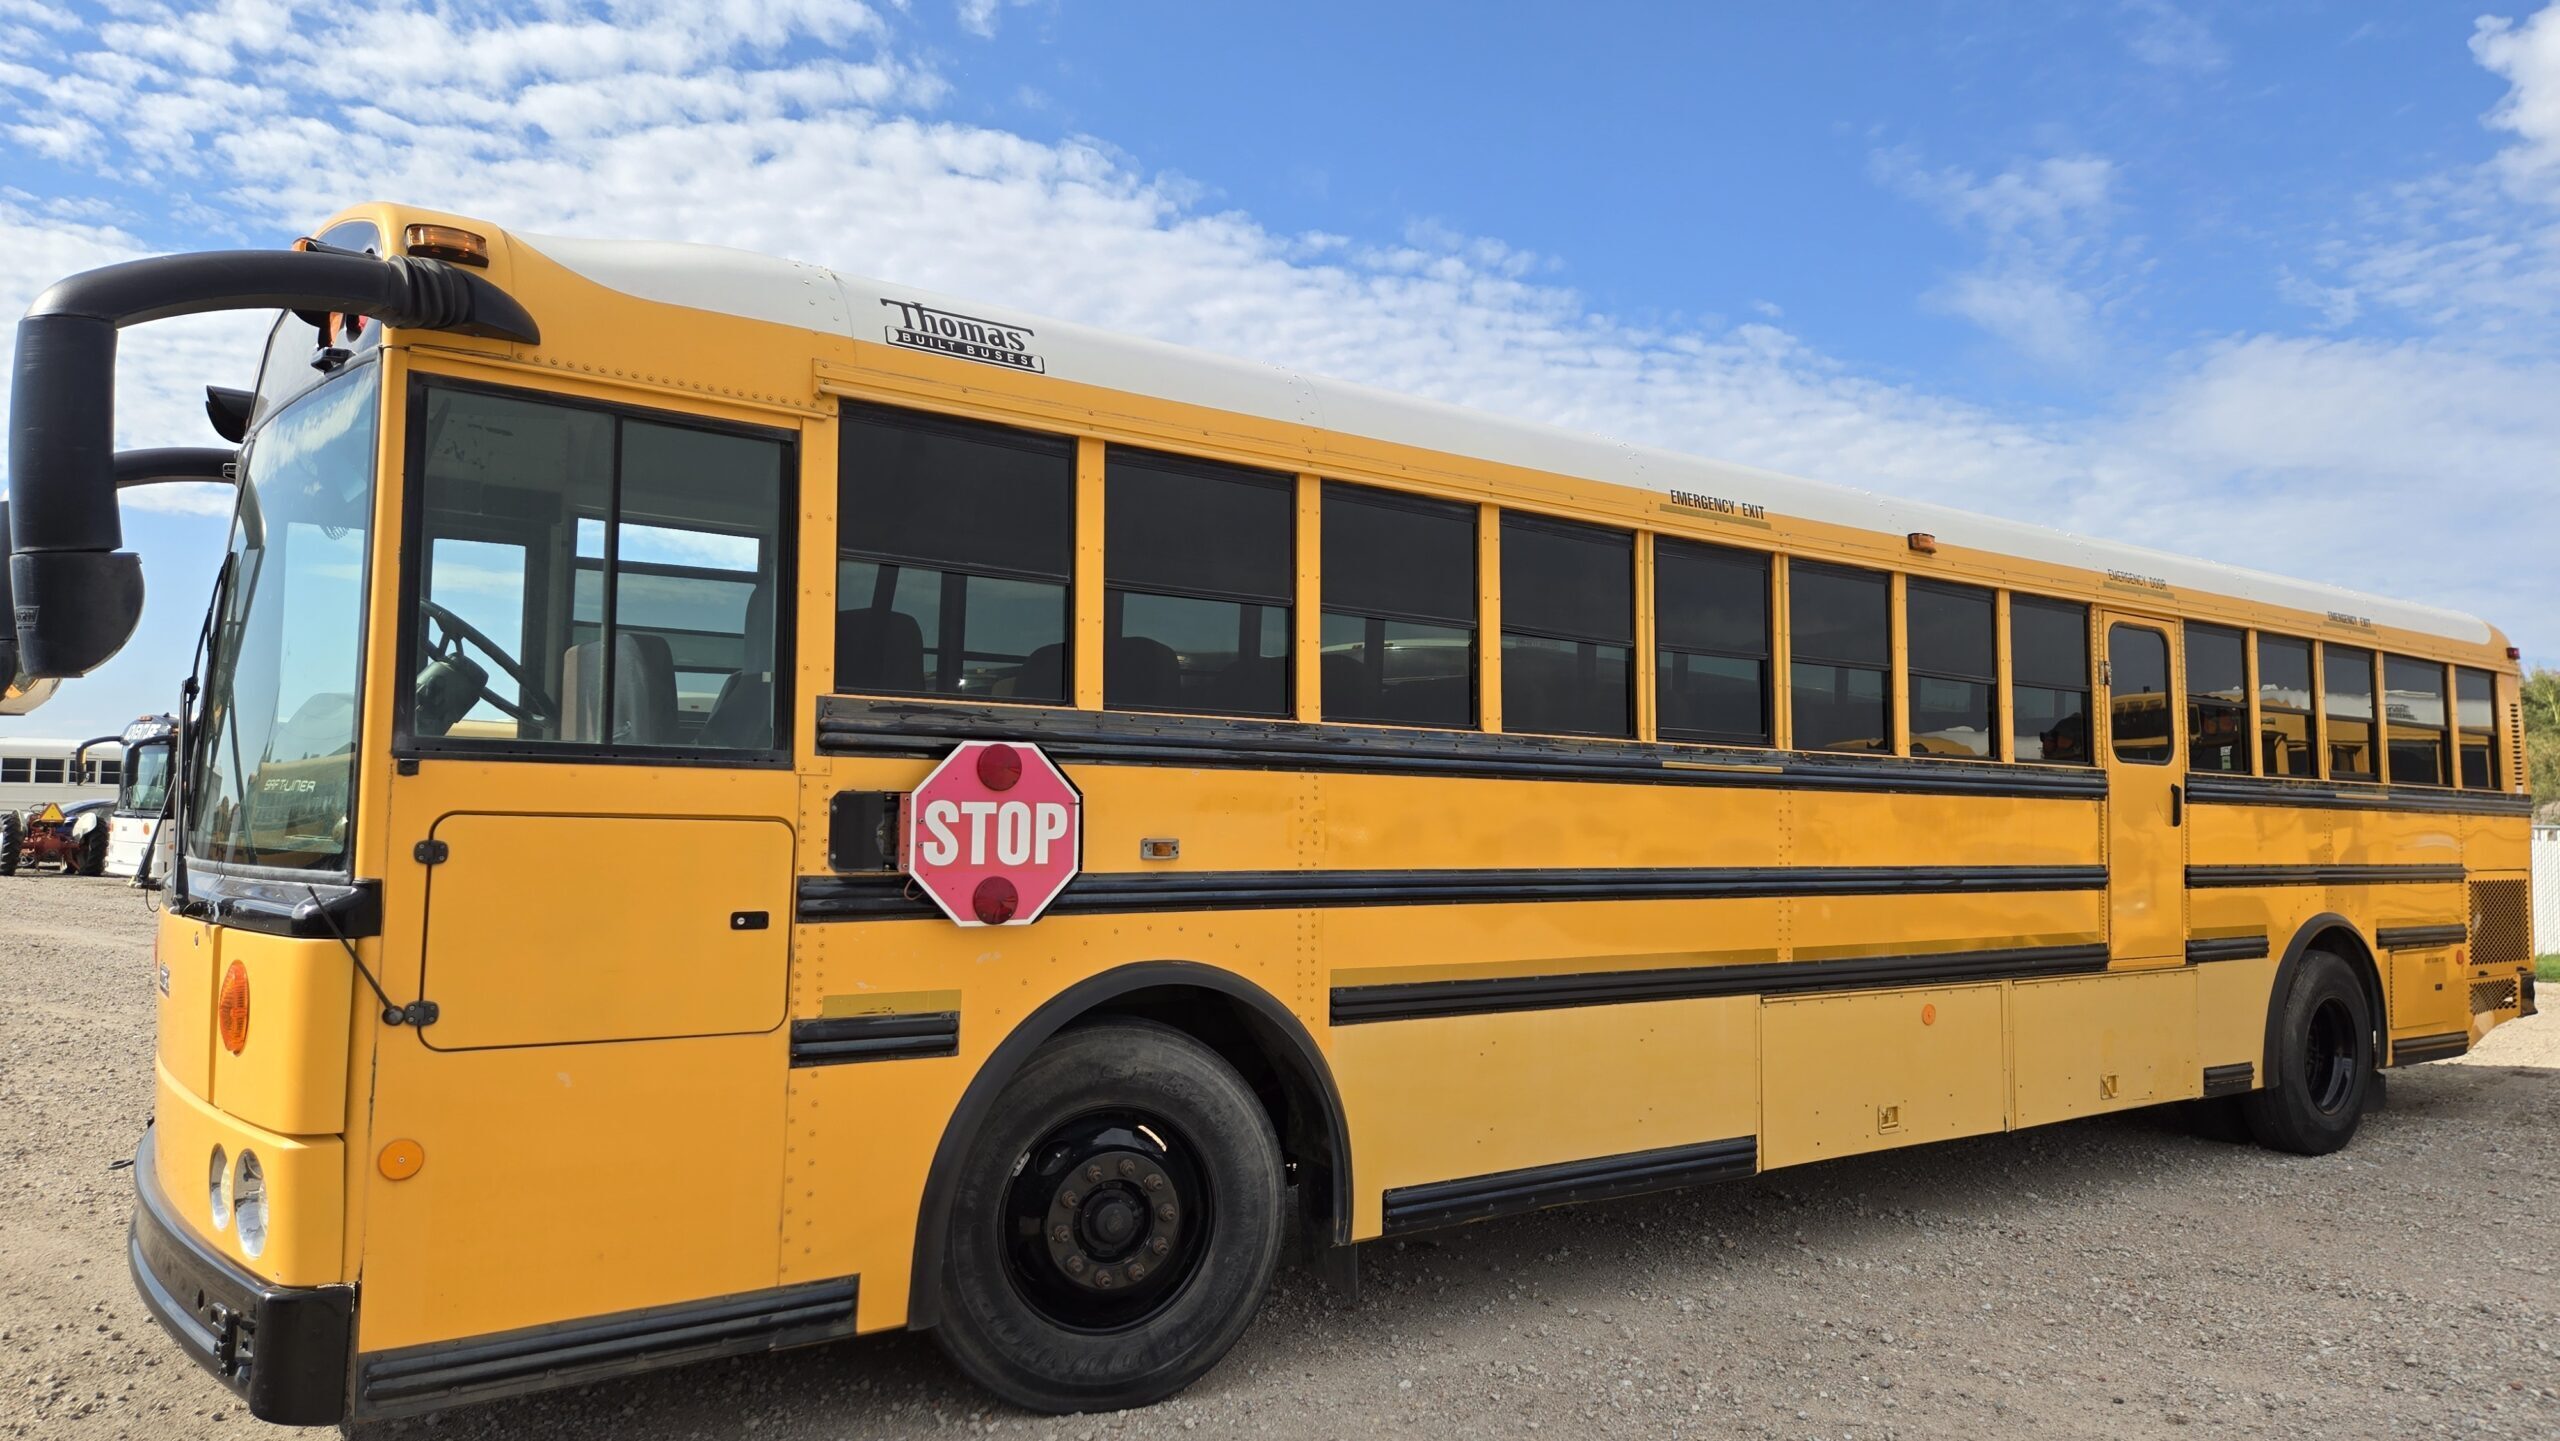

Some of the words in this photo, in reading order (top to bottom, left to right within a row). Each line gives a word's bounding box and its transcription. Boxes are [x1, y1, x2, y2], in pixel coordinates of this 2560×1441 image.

[879, 298, 1035, 352] Thomas
[902, 331, 956, 351] BUILT
[966, 344, 1029, 366] BUSES
[1670, 489, 1735, 515] EMERGENCY
[1742, 502, 1765, 520] EXIT
[2107, 568, 2147, 587] EMERGENCY
[2149, 576, 2168, 591] DOOR
[923, 799, 1069, 867] STOP
